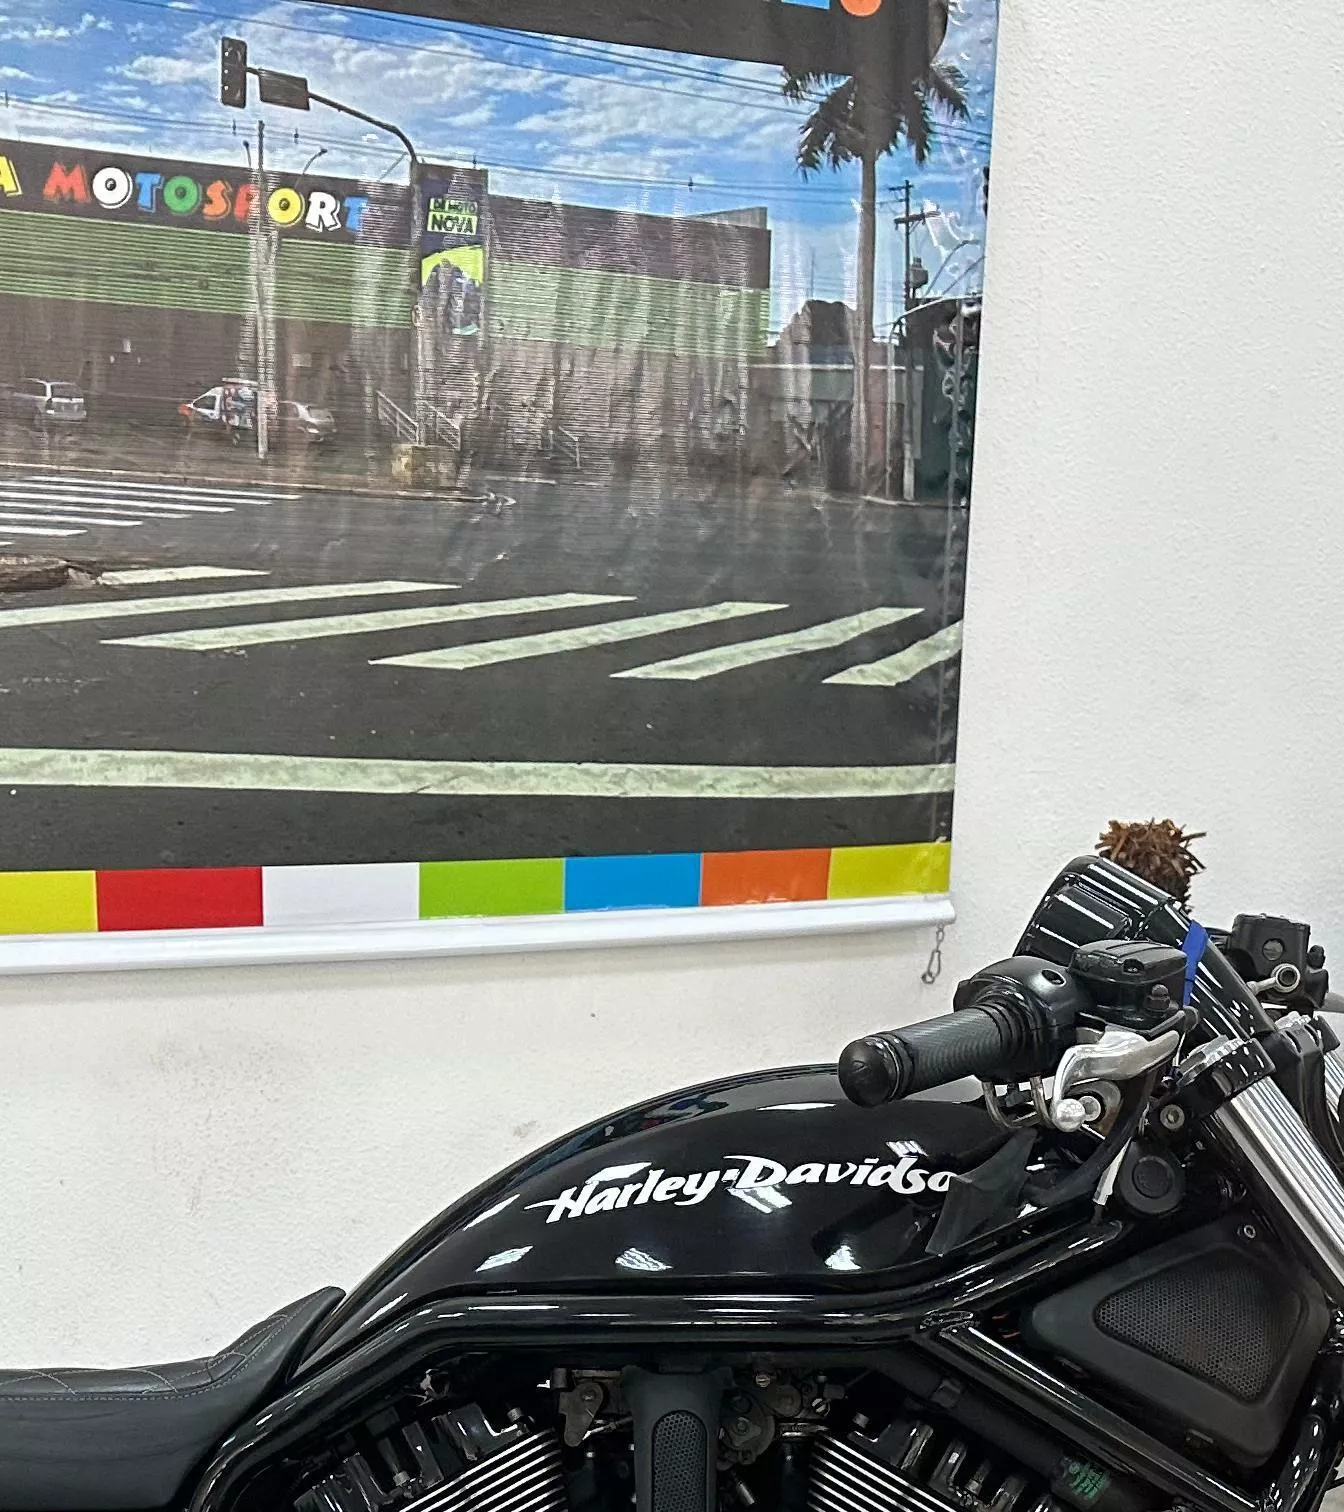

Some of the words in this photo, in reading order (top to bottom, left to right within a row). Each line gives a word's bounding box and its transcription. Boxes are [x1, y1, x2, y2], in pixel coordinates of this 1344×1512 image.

[42, 161, 369, 233] MOTOSPORT
[431, 213, 474, 234] NOVA
[524, 1154, 958, 1225] Harley-Davidso
